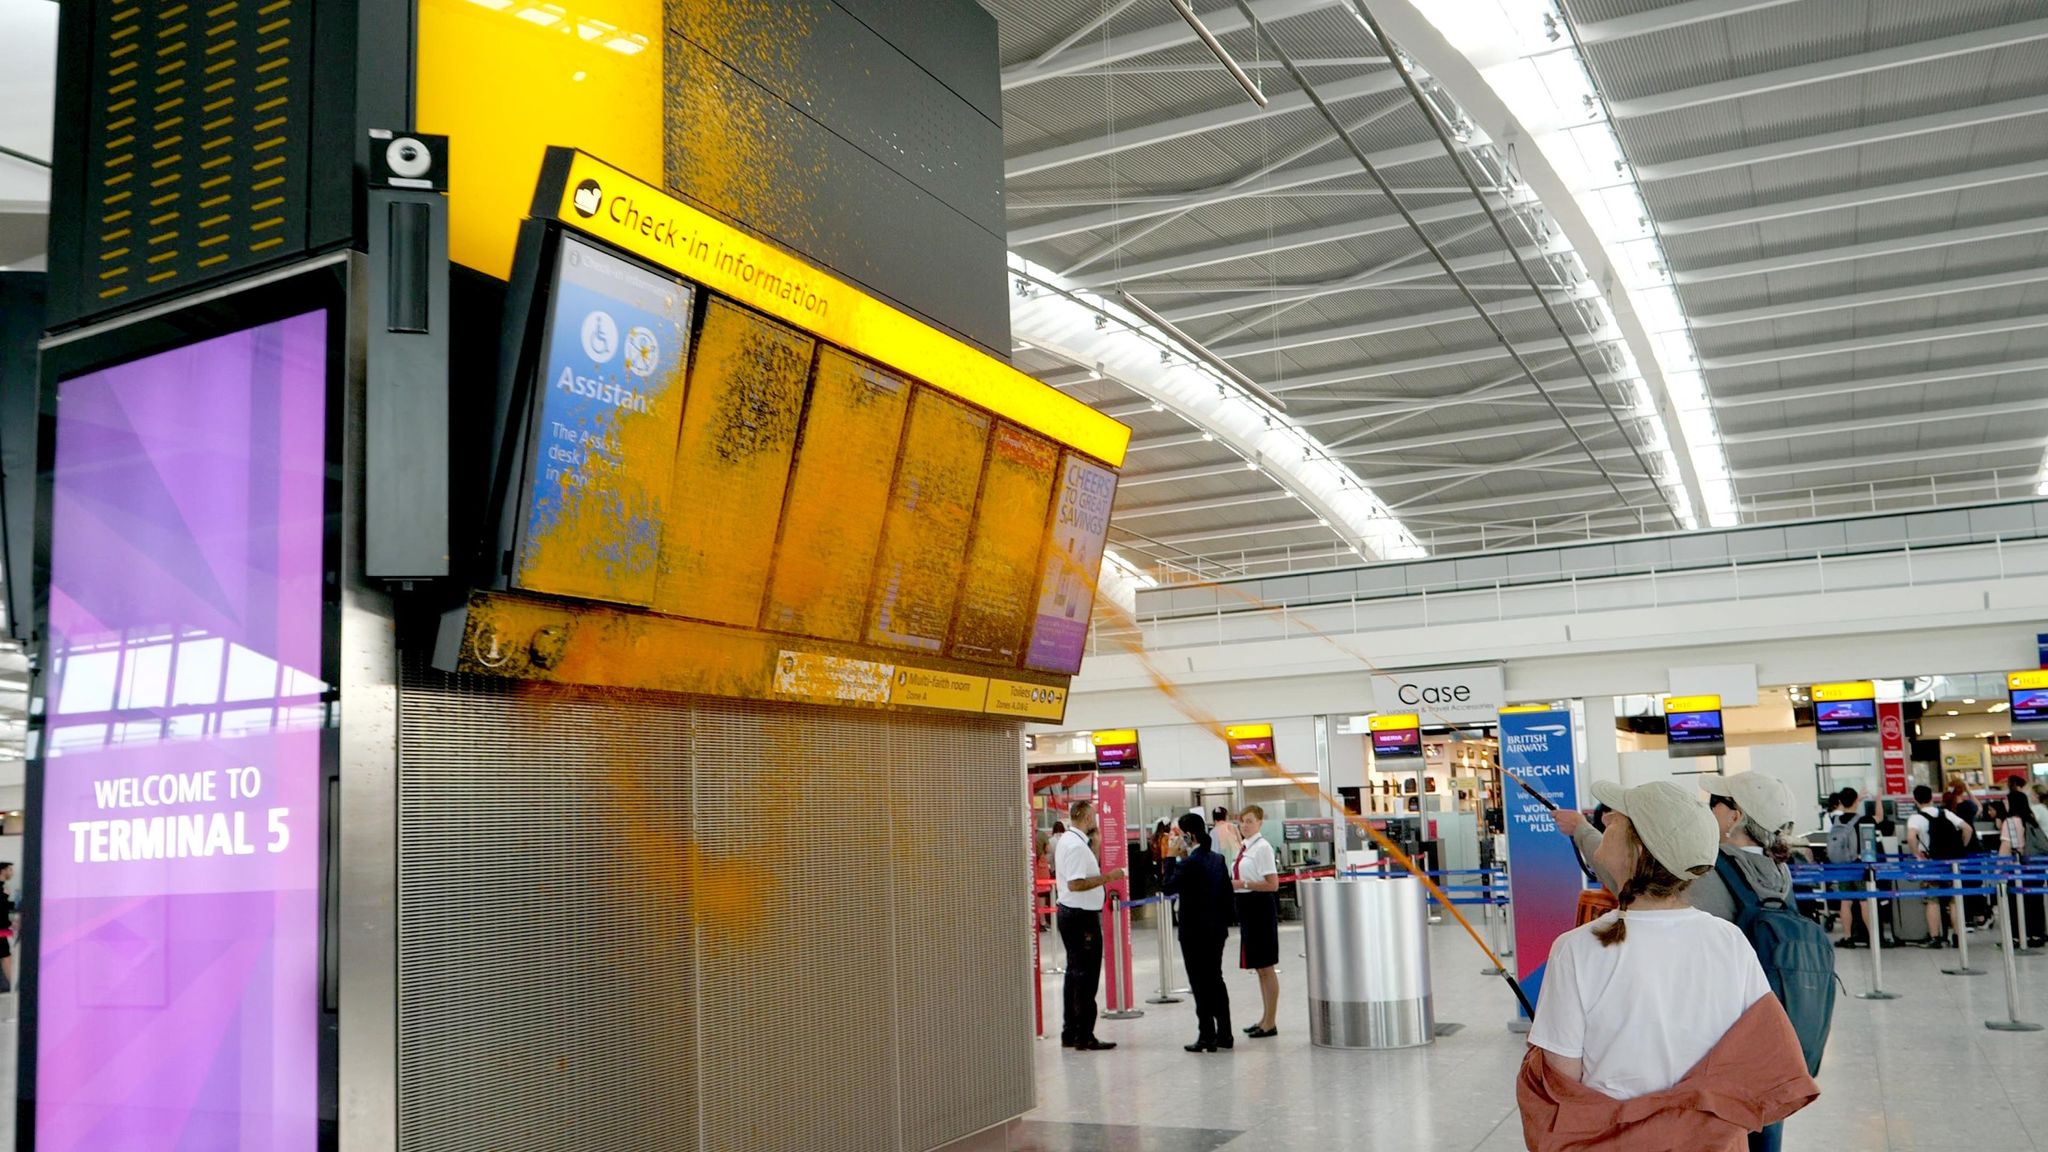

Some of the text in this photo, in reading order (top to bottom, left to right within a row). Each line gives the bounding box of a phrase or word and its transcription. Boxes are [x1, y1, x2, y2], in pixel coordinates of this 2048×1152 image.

[609, 196, 829, 318] Check-in information
[551, 421, 578, 443] The
[547, 442, 580, 466] desk
[545, 463, 560, 482] in
[1068, 465, 1112, 497] CHEERS
[1066, 486, 1108, 514] TO GREAT
[1059, 504, 1104, 536] SAVINGS
[951, 681, 971, 692] room
[1010, 685, 1031, 698] Toilets
[1398, 683, 1471, 705] Case
[1506, 743, 1549, 753] AIRWAYS
[1507, 734, 1547, 744] BRITISH
[1508, 764, 1570, 777] CHECK-IN
[94, 766, 261, 809] WELCOME TO
[1513, 813, 1556, 823] TRAVEL
[1530, 822, 1556, 832] PLUS
[68, 807, 290, 864] TERMINAL 5
